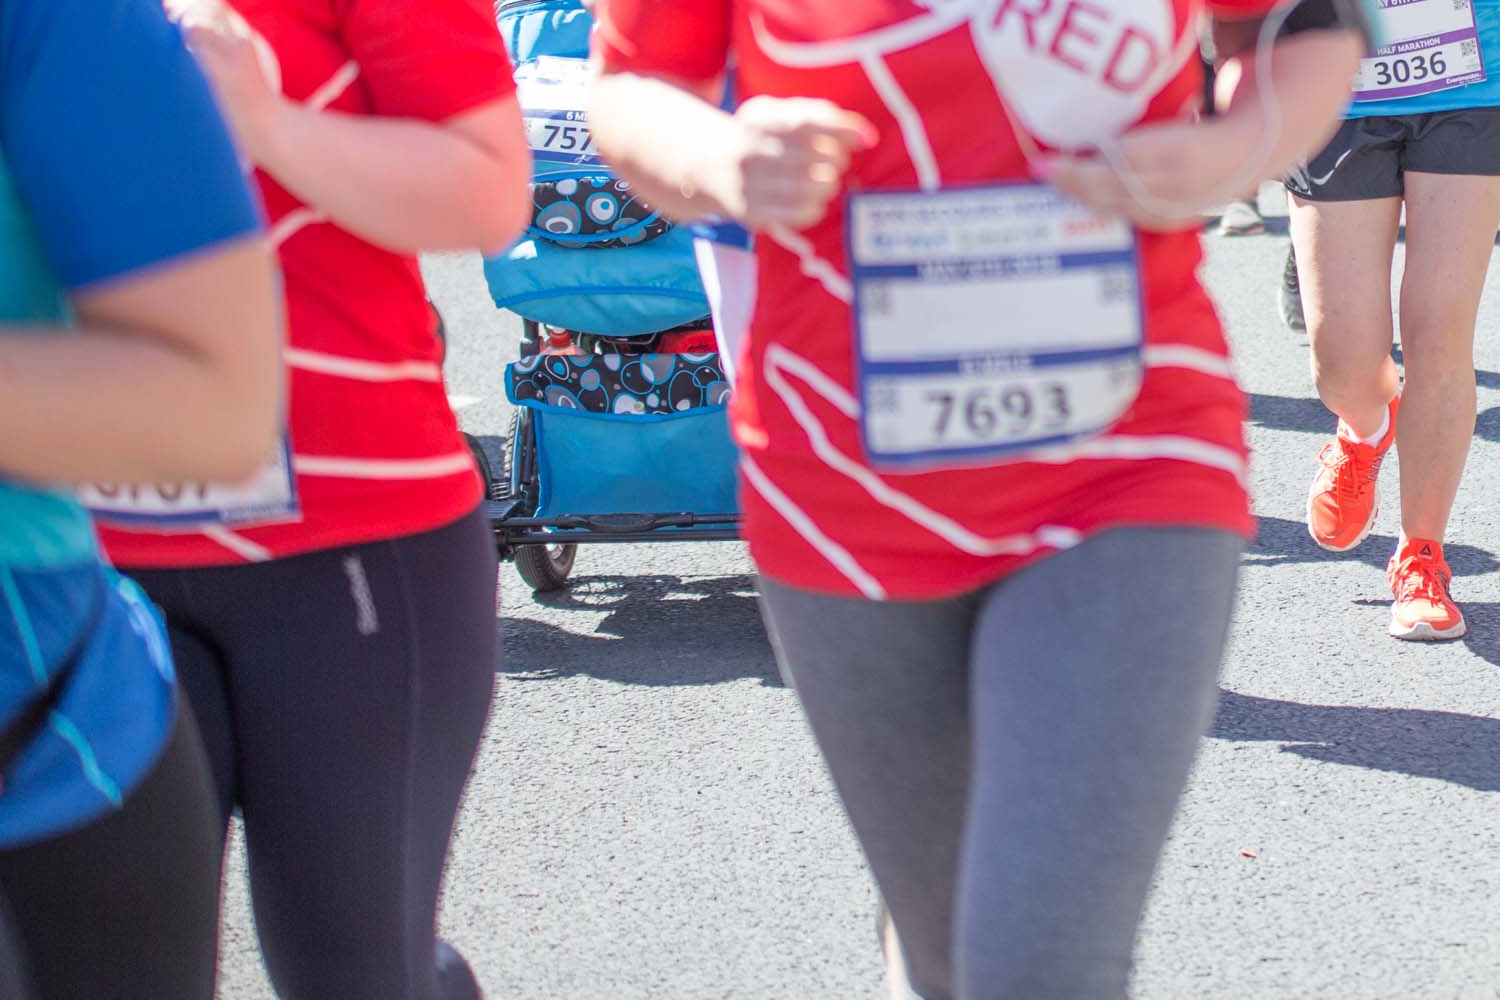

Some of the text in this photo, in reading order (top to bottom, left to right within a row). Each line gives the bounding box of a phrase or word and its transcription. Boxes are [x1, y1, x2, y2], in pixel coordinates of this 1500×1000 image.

[1376, 37, 1441, 56] HALF MARATHON
[1374, 50, 1447, 86] 3036
[566, 111, 574, 120] 6
[543, 125, 593, 152] 757
[926, 383, 1071, 440] 7693
